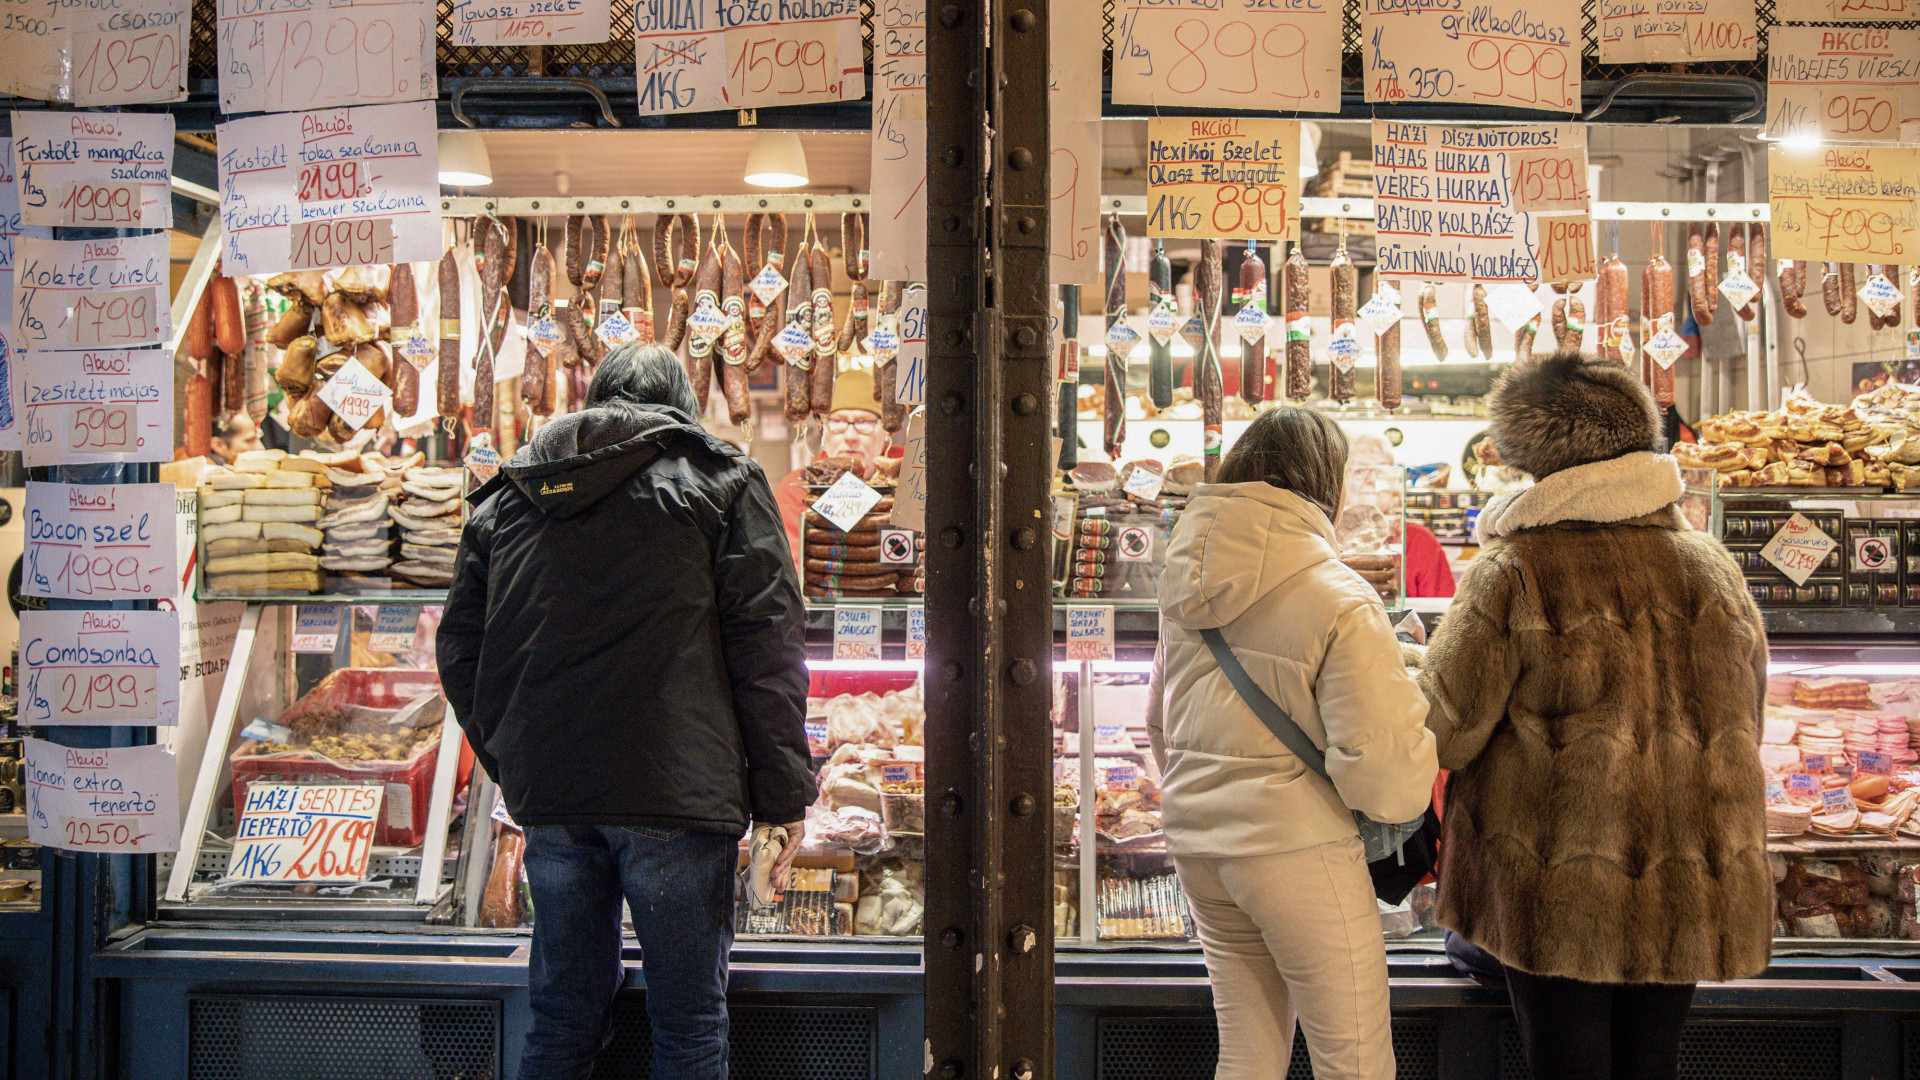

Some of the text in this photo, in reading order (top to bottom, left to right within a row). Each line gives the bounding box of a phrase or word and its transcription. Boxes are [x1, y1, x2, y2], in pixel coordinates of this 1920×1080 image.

[640, 69, 696, 110] 1KG
[88, 141, 165, 165] mangalica
[1435, 151, 1491, 173] HURKA
[110, 162, 169, 180] szalonna
[1437, 176, 1500, 202] HURKA
[1148, 194, 1202, 231] 1KG
[1377, 203, 1516, 236] BAJOR KOLBÁSZ
[1471, 248, 1534, 280] KOLBÁSZ
[30, 509, 87, 541] Bacon
[25, 637, 160, 666] Combsonka
[73, 772, 124, 792] extra
[229, 843, 282, 879] 1KG
